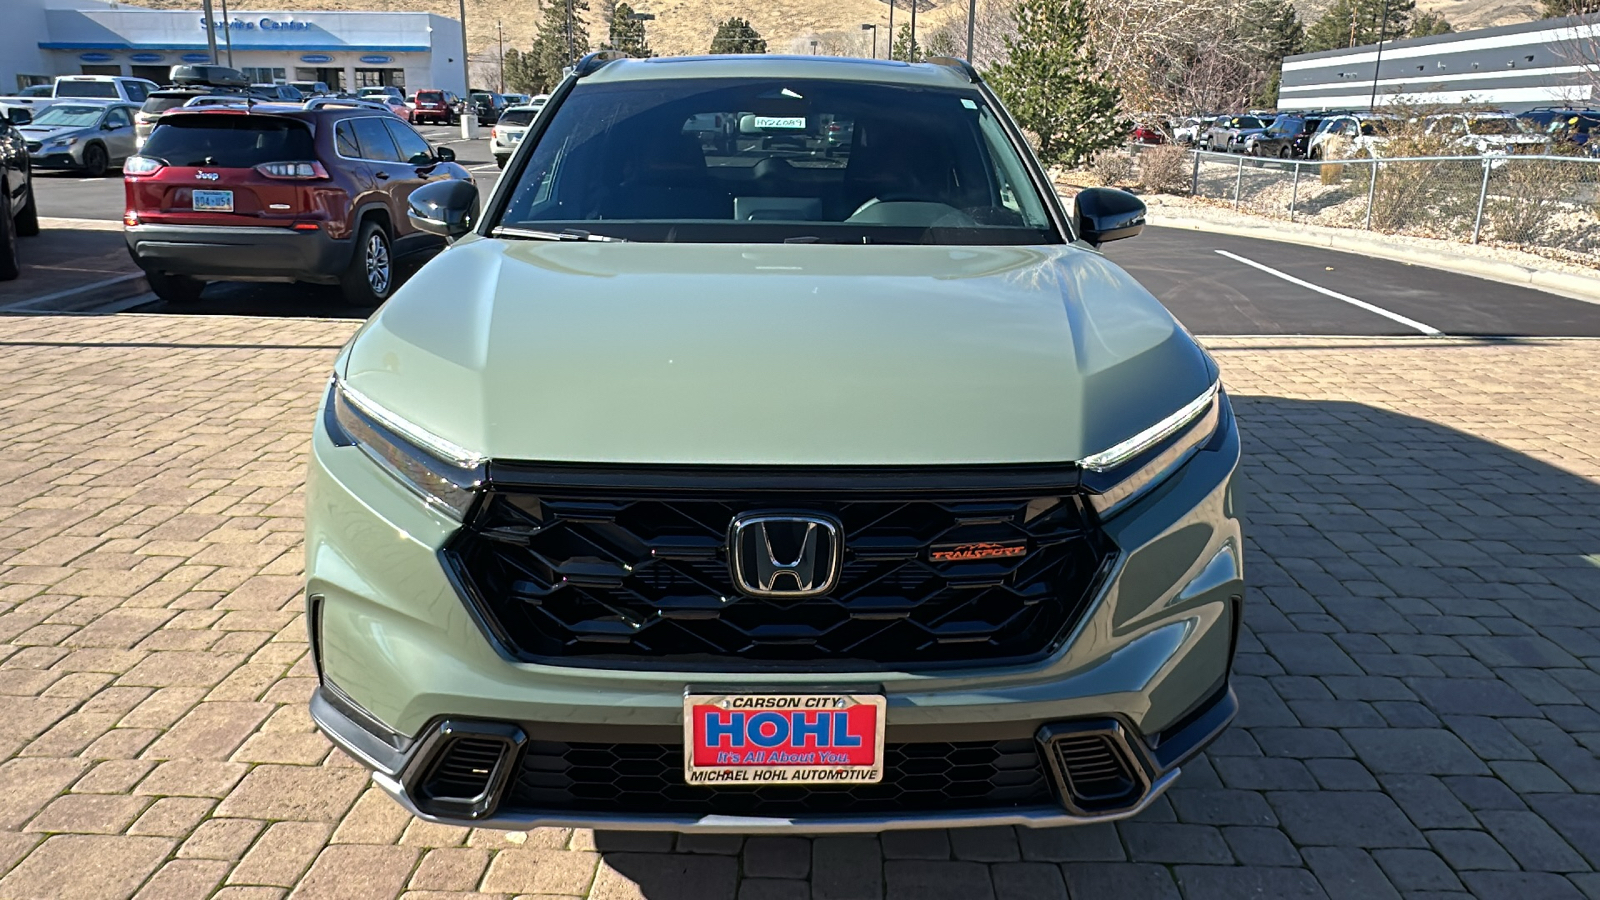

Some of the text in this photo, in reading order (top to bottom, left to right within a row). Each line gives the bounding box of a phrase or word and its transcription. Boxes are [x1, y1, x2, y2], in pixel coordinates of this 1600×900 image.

[260, 17, 312, 31] Center
[195, 170, 218, 180] Jeep
[932, 546, 1024, 560] TRAILSPORT
[732, 697, 841, 708] CARSON CITY
[705, 712, 862, 748] HOHL
[717, 751, 849, 763] It's All About You.
[690, 769, 877, 781] MICHAEL HOHL AUTOMOTIVE
